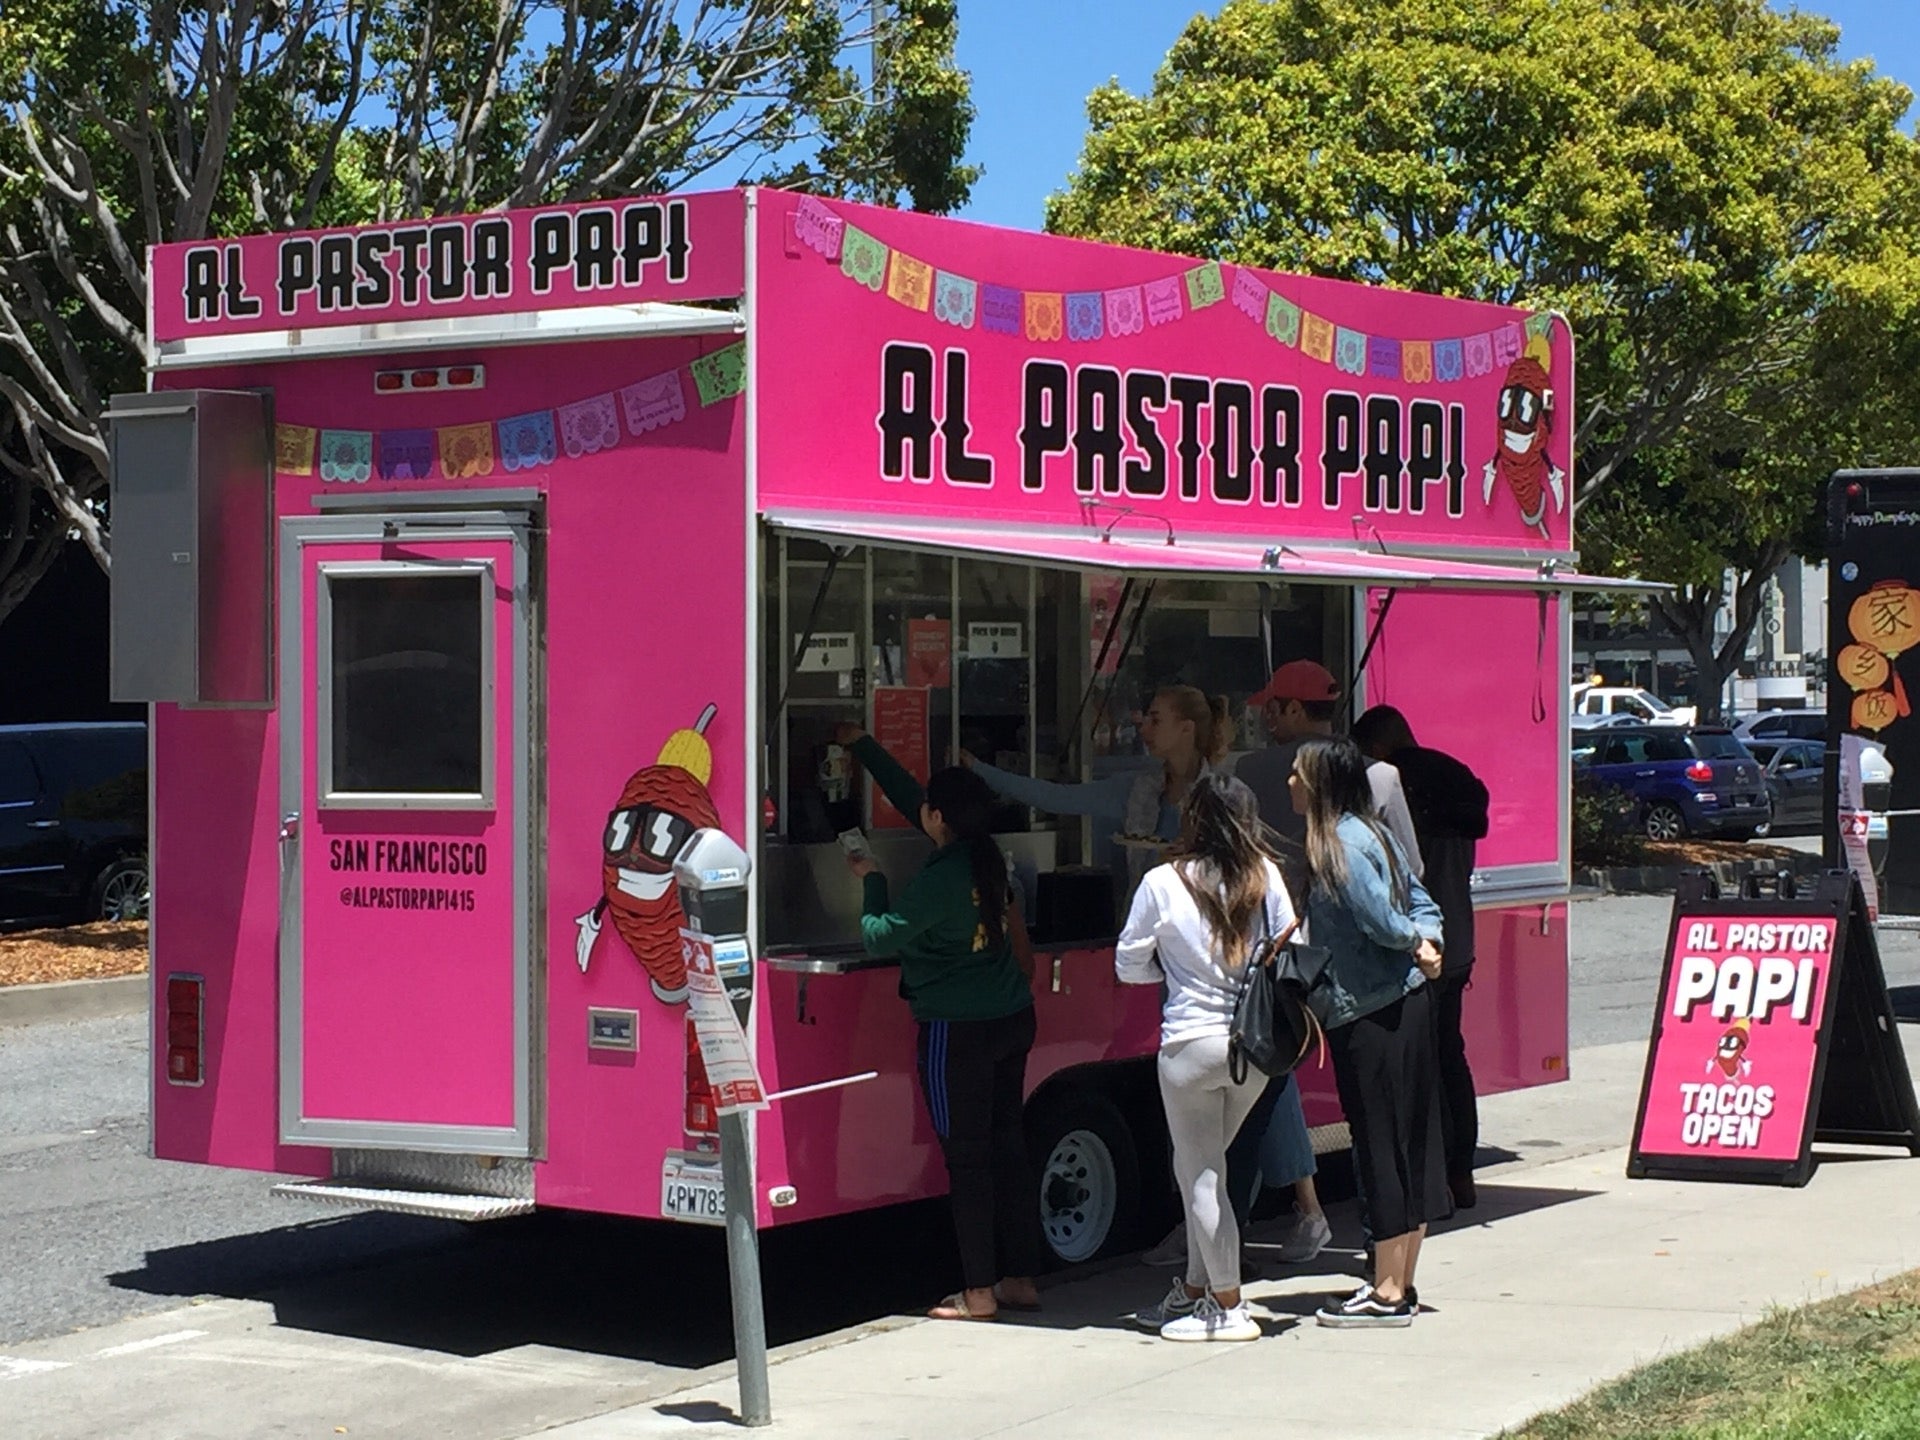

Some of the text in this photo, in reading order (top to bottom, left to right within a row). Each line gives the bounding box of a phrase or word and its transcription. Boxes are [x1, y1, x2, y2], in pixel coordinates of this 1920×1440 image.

[183, 198, 693, 323] AL PASTOR PAPI
[876, 340, 1467, 519] AL PASTOR PAPI
[1868, 587, 1912, 636] 家
[1852, 648, 1876, 676] 乡
[330, 839, 487, 875] SAN FRANCISCO
[340, 886, 475, 912] @ALPASTORPAPI415
[1686, 922, 1828, 952] AL PASTOR
[1672, 955, 1815, 1020] PAPI
[1680, 1083, 1775, 1117] TACOS
[1682, 1114, 1762, 1147] OPEN
